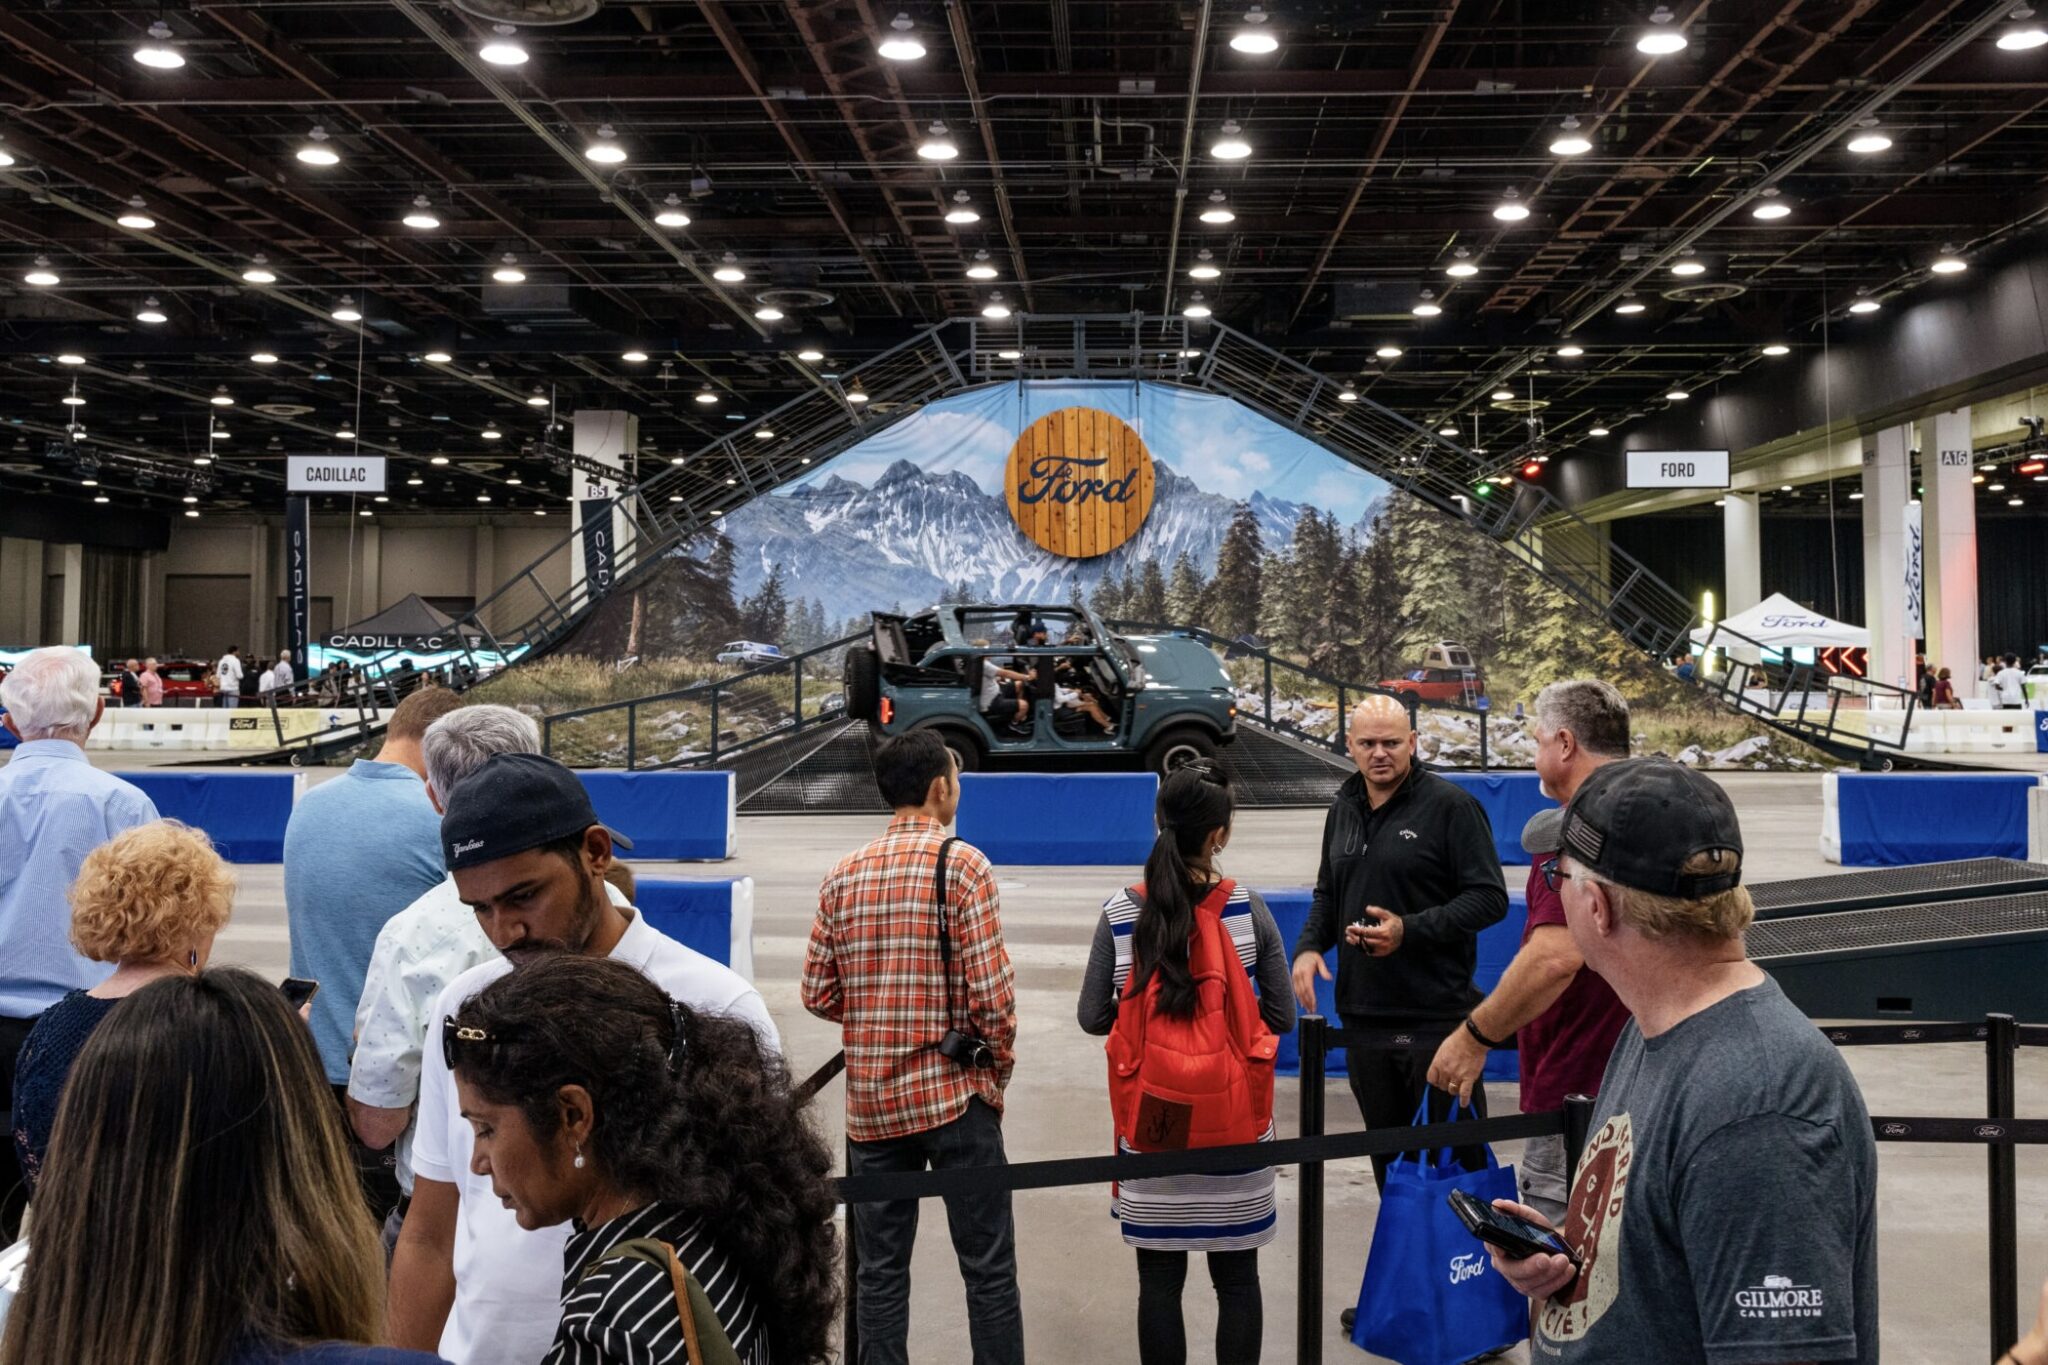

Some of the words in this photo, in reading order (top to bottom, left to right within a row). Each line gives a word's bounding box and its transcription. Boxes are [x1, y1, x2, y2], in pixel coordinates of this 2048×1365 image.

[1943, 451, 1967, 465] A16
[306, 467, 366, 482] CADILLAC
[1661, 462, 1695, 478] FORD
[1019, 456, 1138, 504] Ford
[1905, 523, 1920, 621] Ford
[1761, 614, 1829, 628] Ford
[1903, 1030, 1921, 1039] Ford
[1885, 1124, 1906, 1134] Ford
[1978, 1126, 2000, 1137] Ford
[1450, 1252, 1485, 1284] Ford
[1735, 1289, 1823, 1308] GILMORE
[1740, 1309, 1765, 1318] CAR
[1771, 1308, 1822, 1318] MUSEUM
